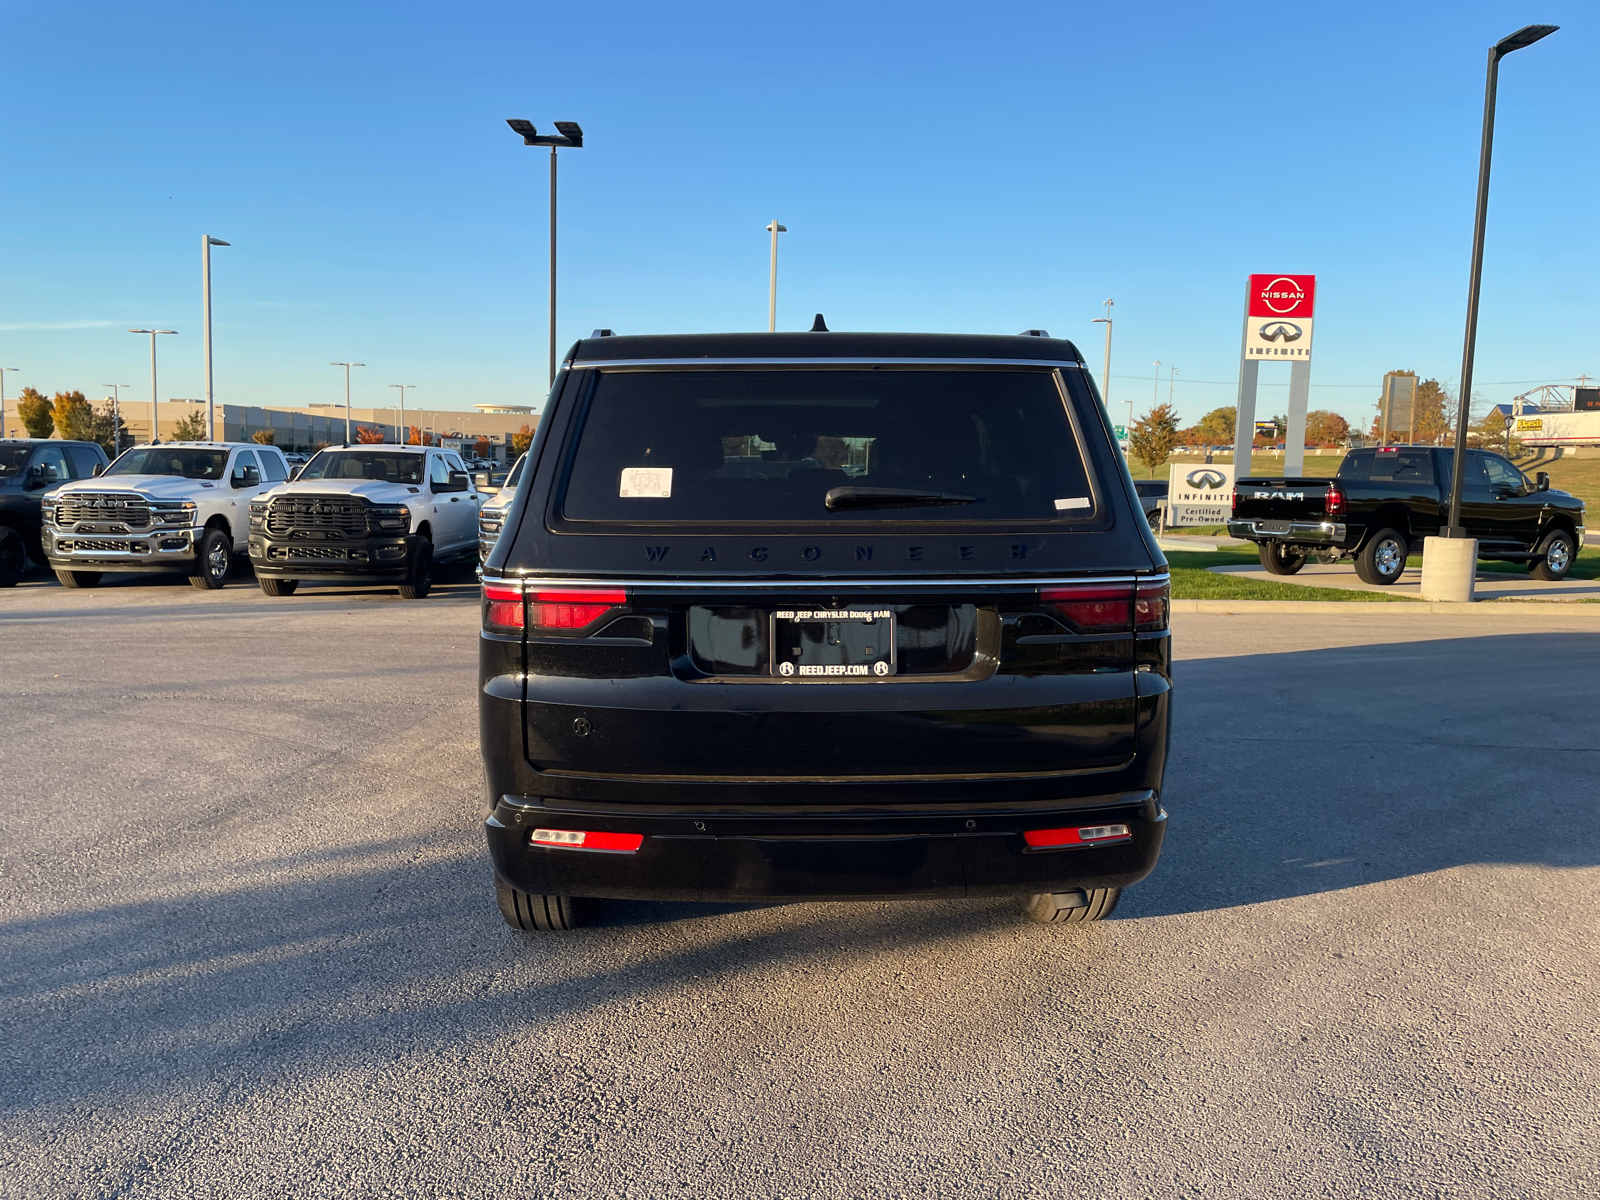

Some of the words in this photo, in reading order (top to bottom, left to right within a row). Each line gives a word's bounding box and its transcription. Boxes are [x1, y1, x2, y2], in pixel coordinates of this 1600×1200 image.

[1261, 291, 1305, 299] NISSAN
[1249, 347, 1310, 356] INFINITI
[1178, 493, 1230, 501] INFINITI
[1254, 491, 1304, 501] RAM
[75, 499, 124, 508] RAM
[292, 504, 341, 513] RAM
[1185, 507, 1222, 515] Certified
[1180, 515, 1226, 523] Pre-Owned
[643, 545, 1029, 562] WAGONEER
[776, 611, 795, 619] REED
[796, 611, 812, 619] JEEP
[814, 611, 848, 619] CHRYSLER
[873, 610, 891, 618] RAM
[799, 665, 869, 676] REEDJEEP.COM
